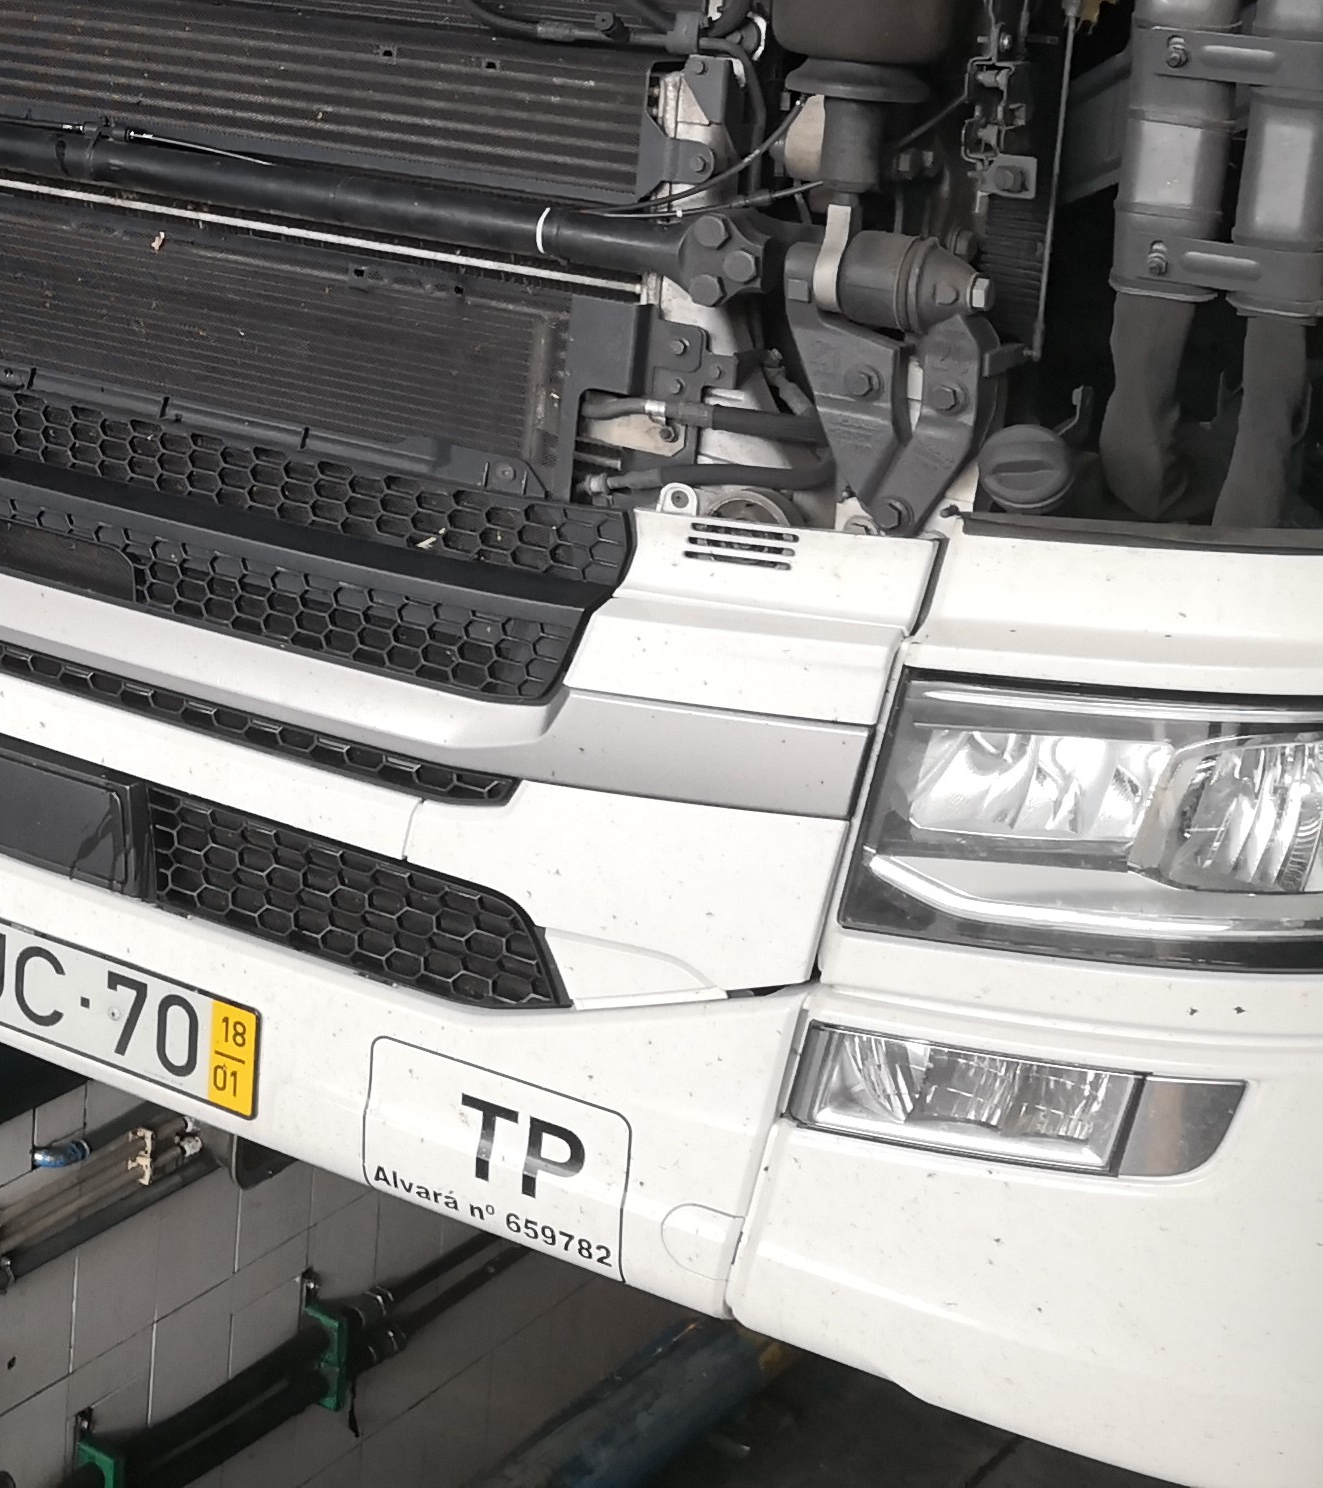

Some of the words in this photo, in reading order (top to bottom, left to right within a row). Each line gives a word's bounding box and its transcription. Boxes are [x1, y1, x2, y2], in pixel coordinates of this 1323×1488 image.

[221, 1016, 247, 1048] 18
[213, 1065, 239, 1097] 01
[461, 1092, 585, 1199] TP
[374, 1165, 459, 1212] Alvará
[505, 1212, 613, 1268] 659782
